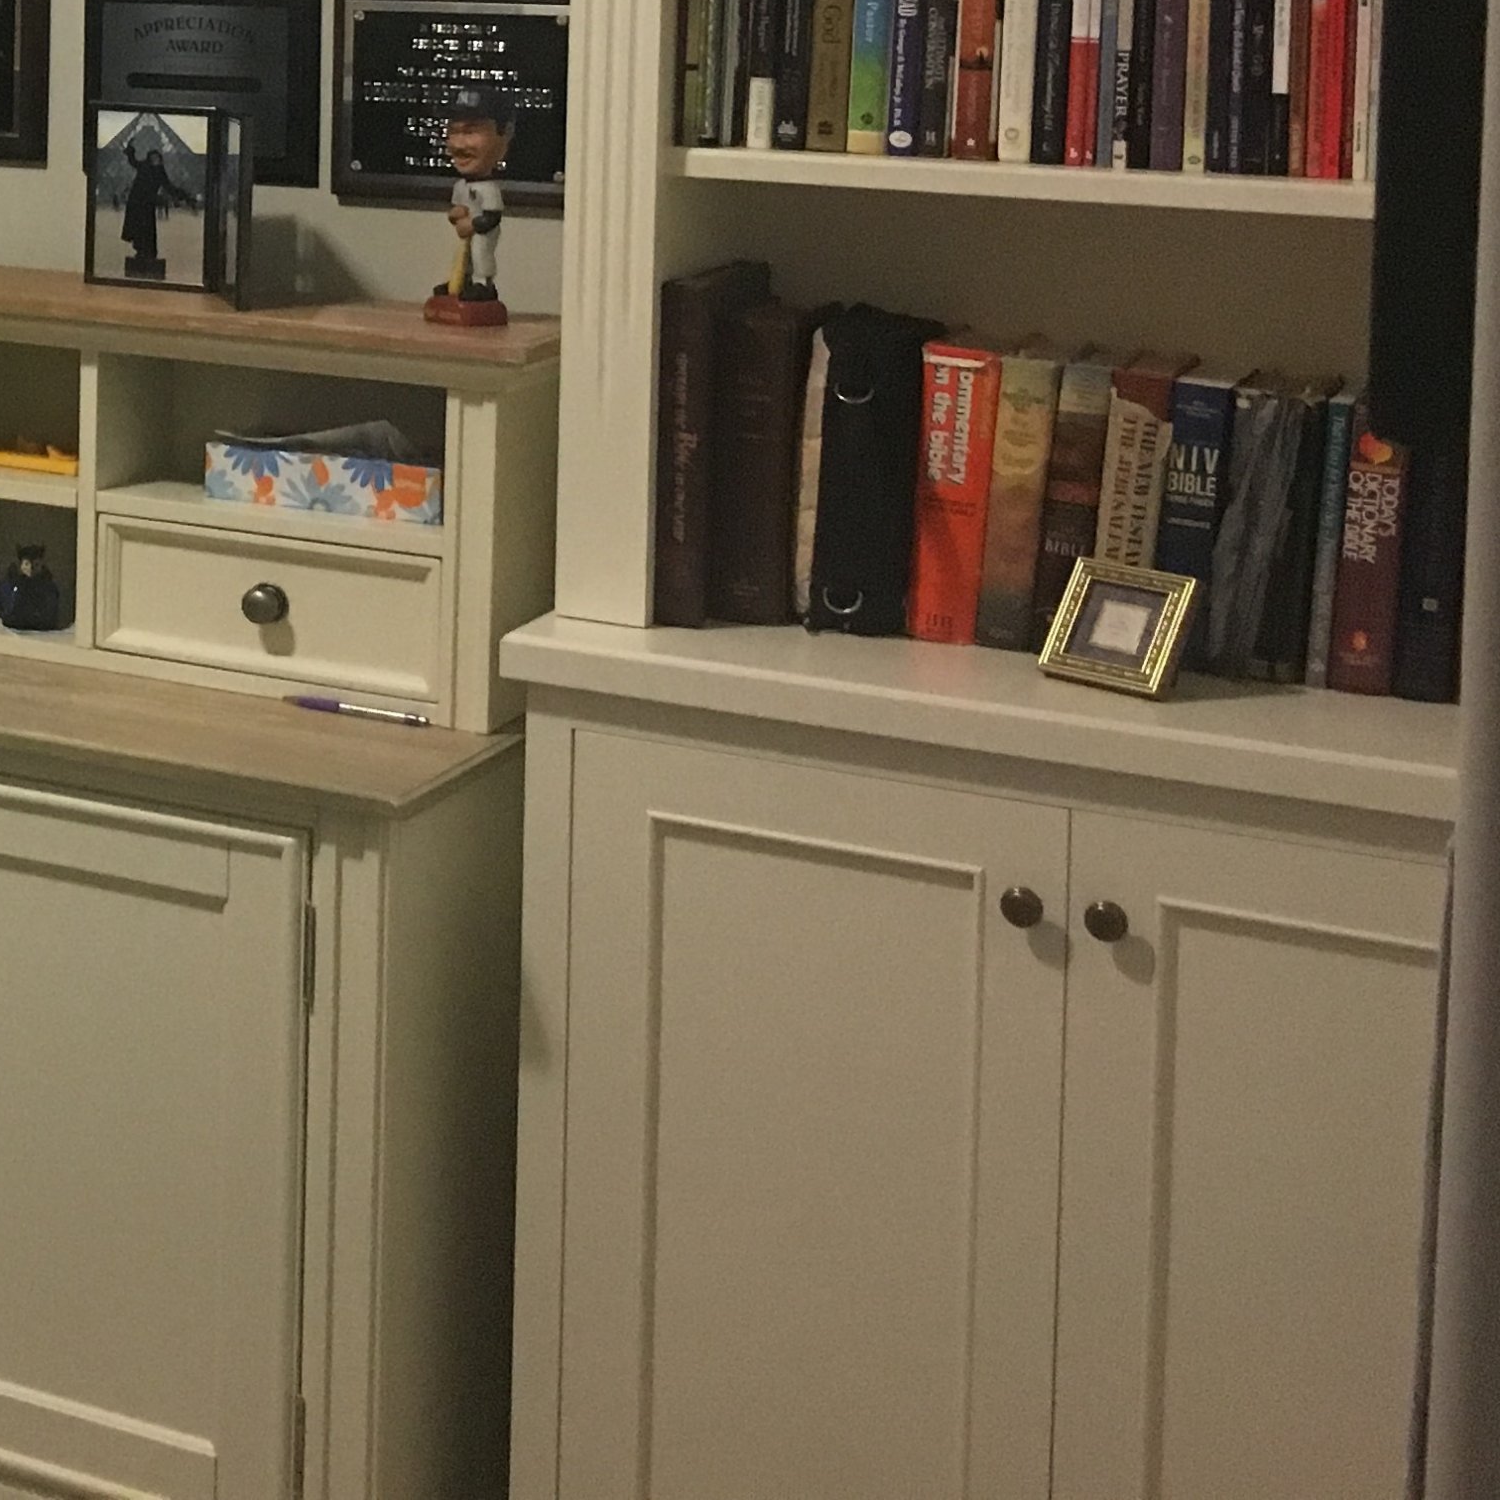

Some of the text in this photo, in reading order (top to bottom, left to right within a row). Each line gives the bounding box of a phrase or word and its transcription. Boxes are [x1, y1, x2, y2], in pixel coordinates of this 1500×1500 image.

[132, 15, 256, 45] APPRECIATION
[821, 4, 844, 45] God
[864, 1, 879, 43] Pastor
[165, 38, 224, 54] AWARD
[1114, 51, 1130, 118] PRAYER
[930, 391, 950, 425] the
[948, 368, 976, 485] ommentary
[926, 430, 950, 483] bible
[1169, 442, 1220, 476] NIV
[1167, 471, 1217, 497] BIBLE
[1342, 471, 1364, 561] OF THE BIBLE
[1360, 471, 1383, 564] DICTIONARY
